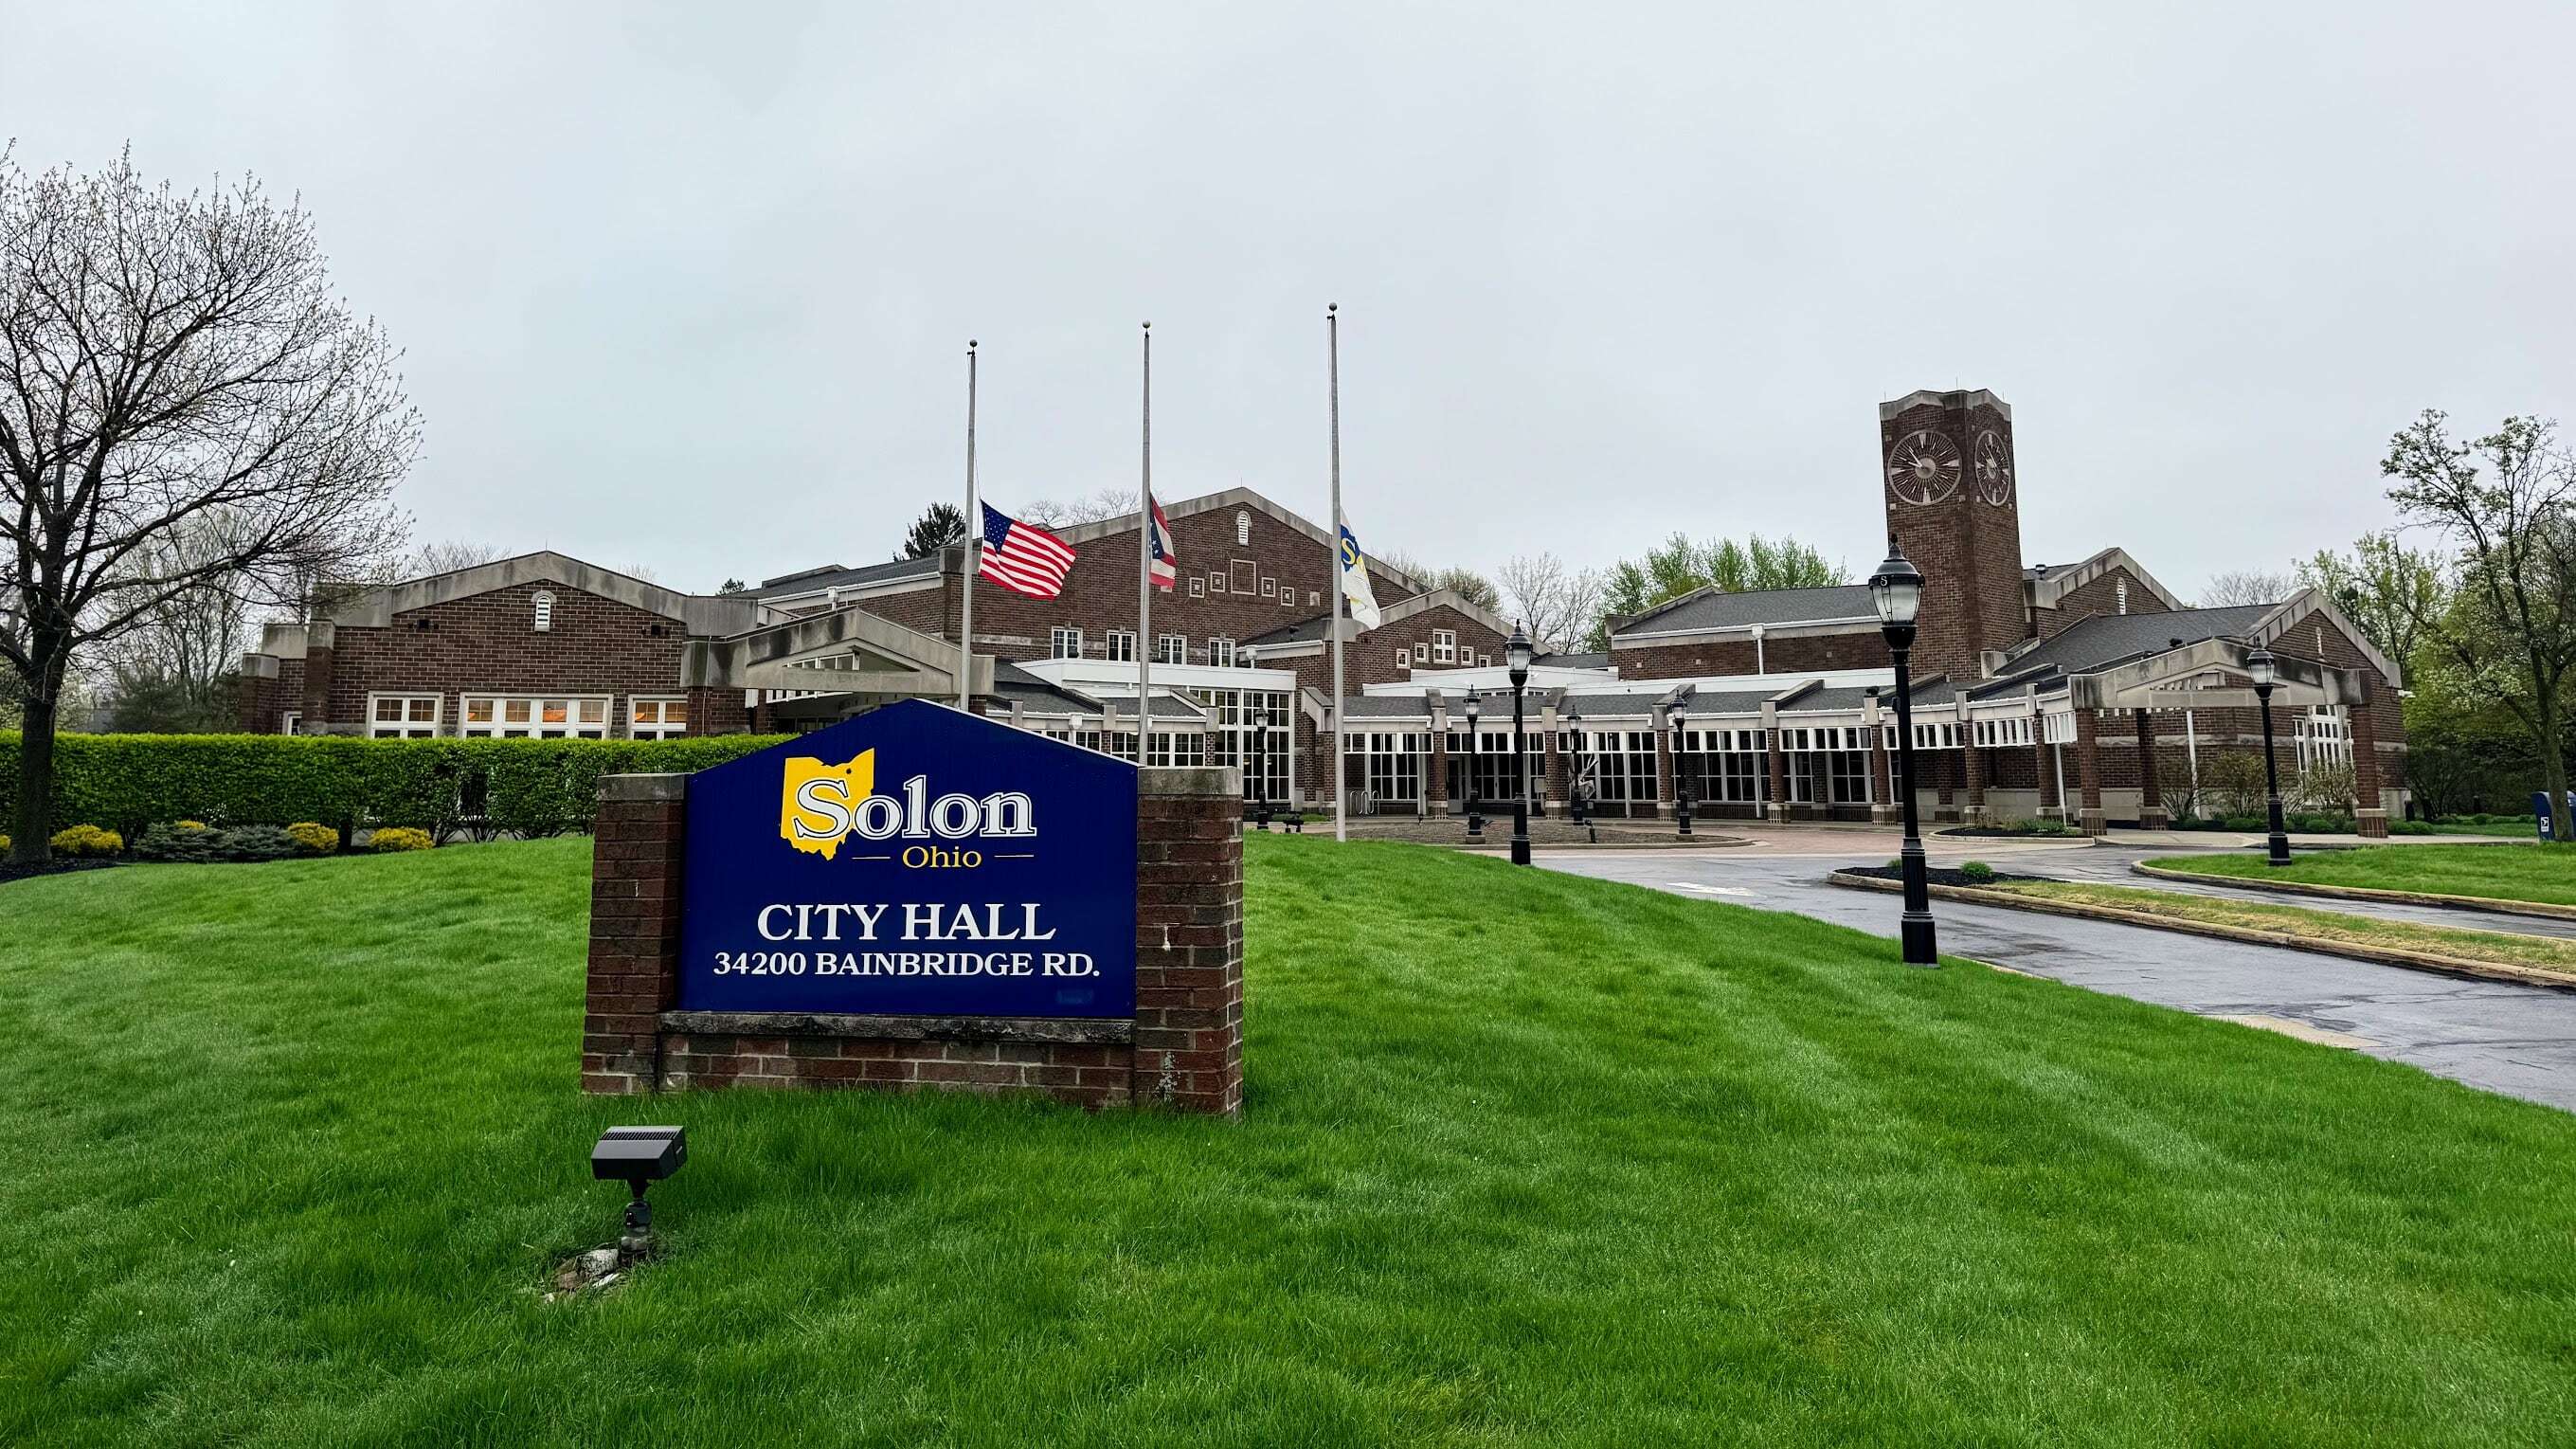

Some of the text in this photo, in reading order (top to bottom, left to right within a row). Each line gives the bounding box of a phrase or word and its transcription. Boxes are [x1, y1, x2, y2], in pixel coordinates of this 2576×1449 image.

[793, 774, 1037, 841] Solon
[902, 845, 982, 869] Ohio
[757, 902, 1057, 941] CITY HALL
[712, 951, 1101, 978] 34200 BAINBRIDGE RD.
